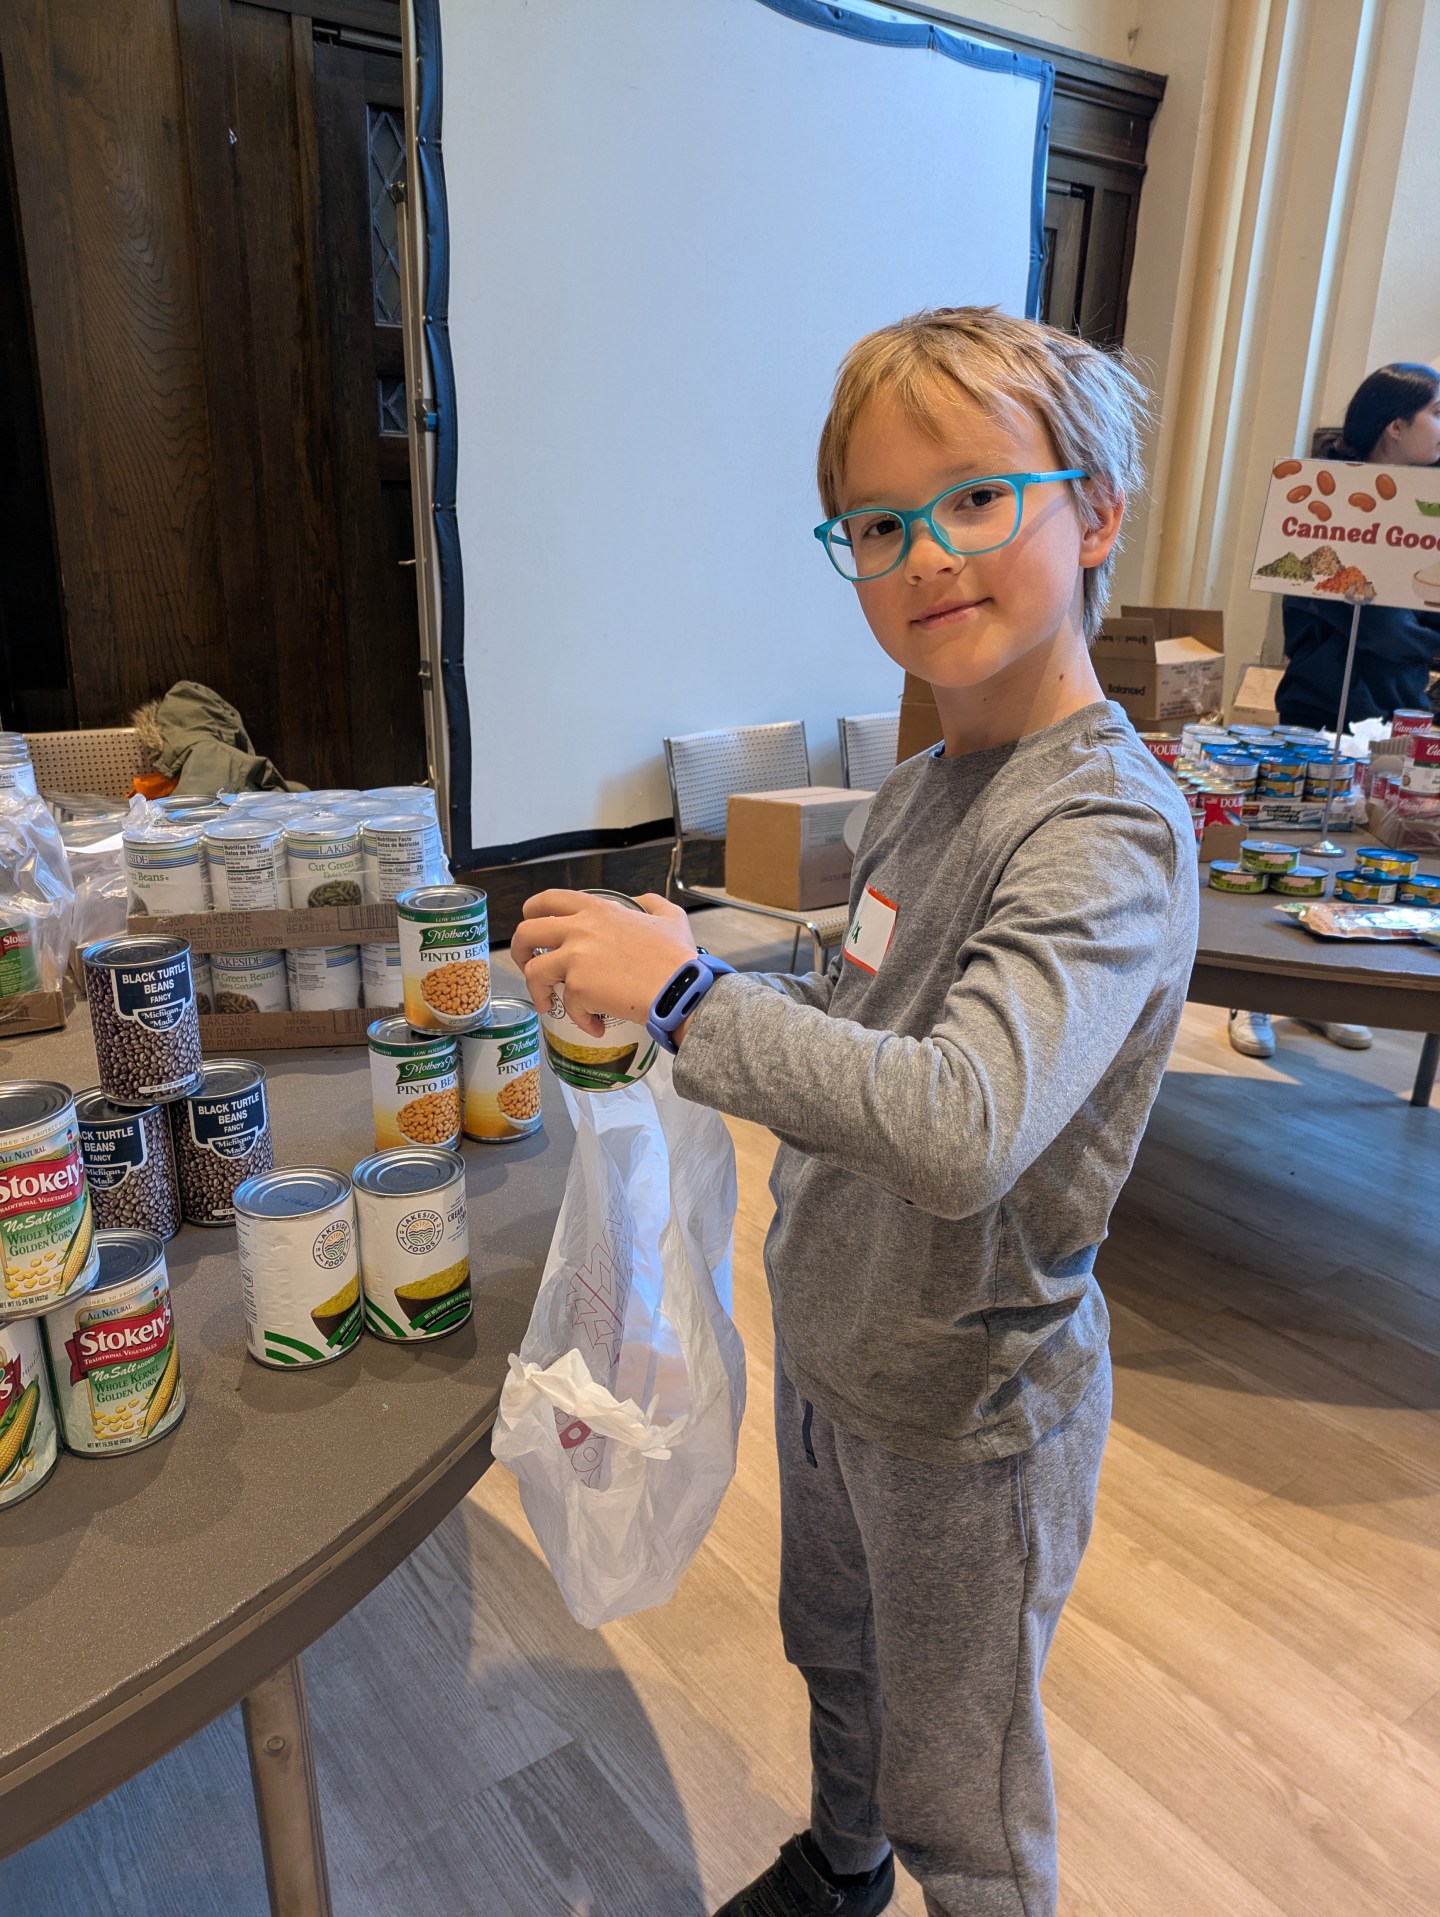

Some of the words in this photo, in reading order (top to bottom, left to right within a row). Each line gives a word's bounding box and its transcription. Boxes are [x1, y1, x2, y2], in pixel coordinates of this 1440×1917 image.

[1282, 516, 1381, 545] Canned
[308, 862, 325, 872] Cut
[327, 859, 354, 871] Green
[138, 871, 165, 882] Beans
[201, 912, 253, 926] LAKESIDE
[173, 927, 212, 939] GREEN
[215, 926, 250, 938] BEANS
[425, 929, 470, 945] Mother's
[214, 955, 262, 967] LAKESIDE
[420, 951, 461, 962] PINTO
[122, 971, 156, 985] BLACK
[157, 961, 186, 980] TURTLE
[221, 973, 248, 983] Green
[250, 970, 276, 982] Beans
[144, 979, 175, 995] BEANS
[150, 993, 172, 1004] FANCY
[142, 1007, 179, 1020] Michigan
[201, 1014, 250, 1026] LAKESIDE
[151, 1016, 174, 1028] Made
[217, 1027, 250, 1038] BEANS
[402, 1062, 445, 1078] Mother's
[497, 1060, 532, 1076] PINTO
[397, 1082, 437, 1095] PINTO
[198, 1103, 230, 1115] BLACK
[231, 1092, 260, 1111] TURTLE
[218, 1109, 248, 1125] BEANS
[33, 1124, 58, 1137] PROTECT
[96, 1126, 134, 1141] TURTLE
[224, 1122, 245, 1133] FANCY
[84, 1142, 116, 1152] BEANS
[216, 1135, 252, 1148] Michigan
[90, 1154, 112, 1162] FANCY
[3, 1219, 24, 1233] No
[24, 1210, 53, 1229] Salt
[53, 1206, 71, 1219] ADDED
[401, 1212, 439, 1228] LAKESIDE
[318, 1222, 348, 1244] LAKESIDE
[408, 1241, 436, 1253] FOODS
[324, 1251, 347, 1267] FOODS
[8, 1300, 15, 1308] WT
[80, 1300, 171, 1356] Stokely's
[92, 1370, 110, 1382] No
[110, 1362, 137, 1379] Salt
[137, 1357, 155, 1369] ADDED
